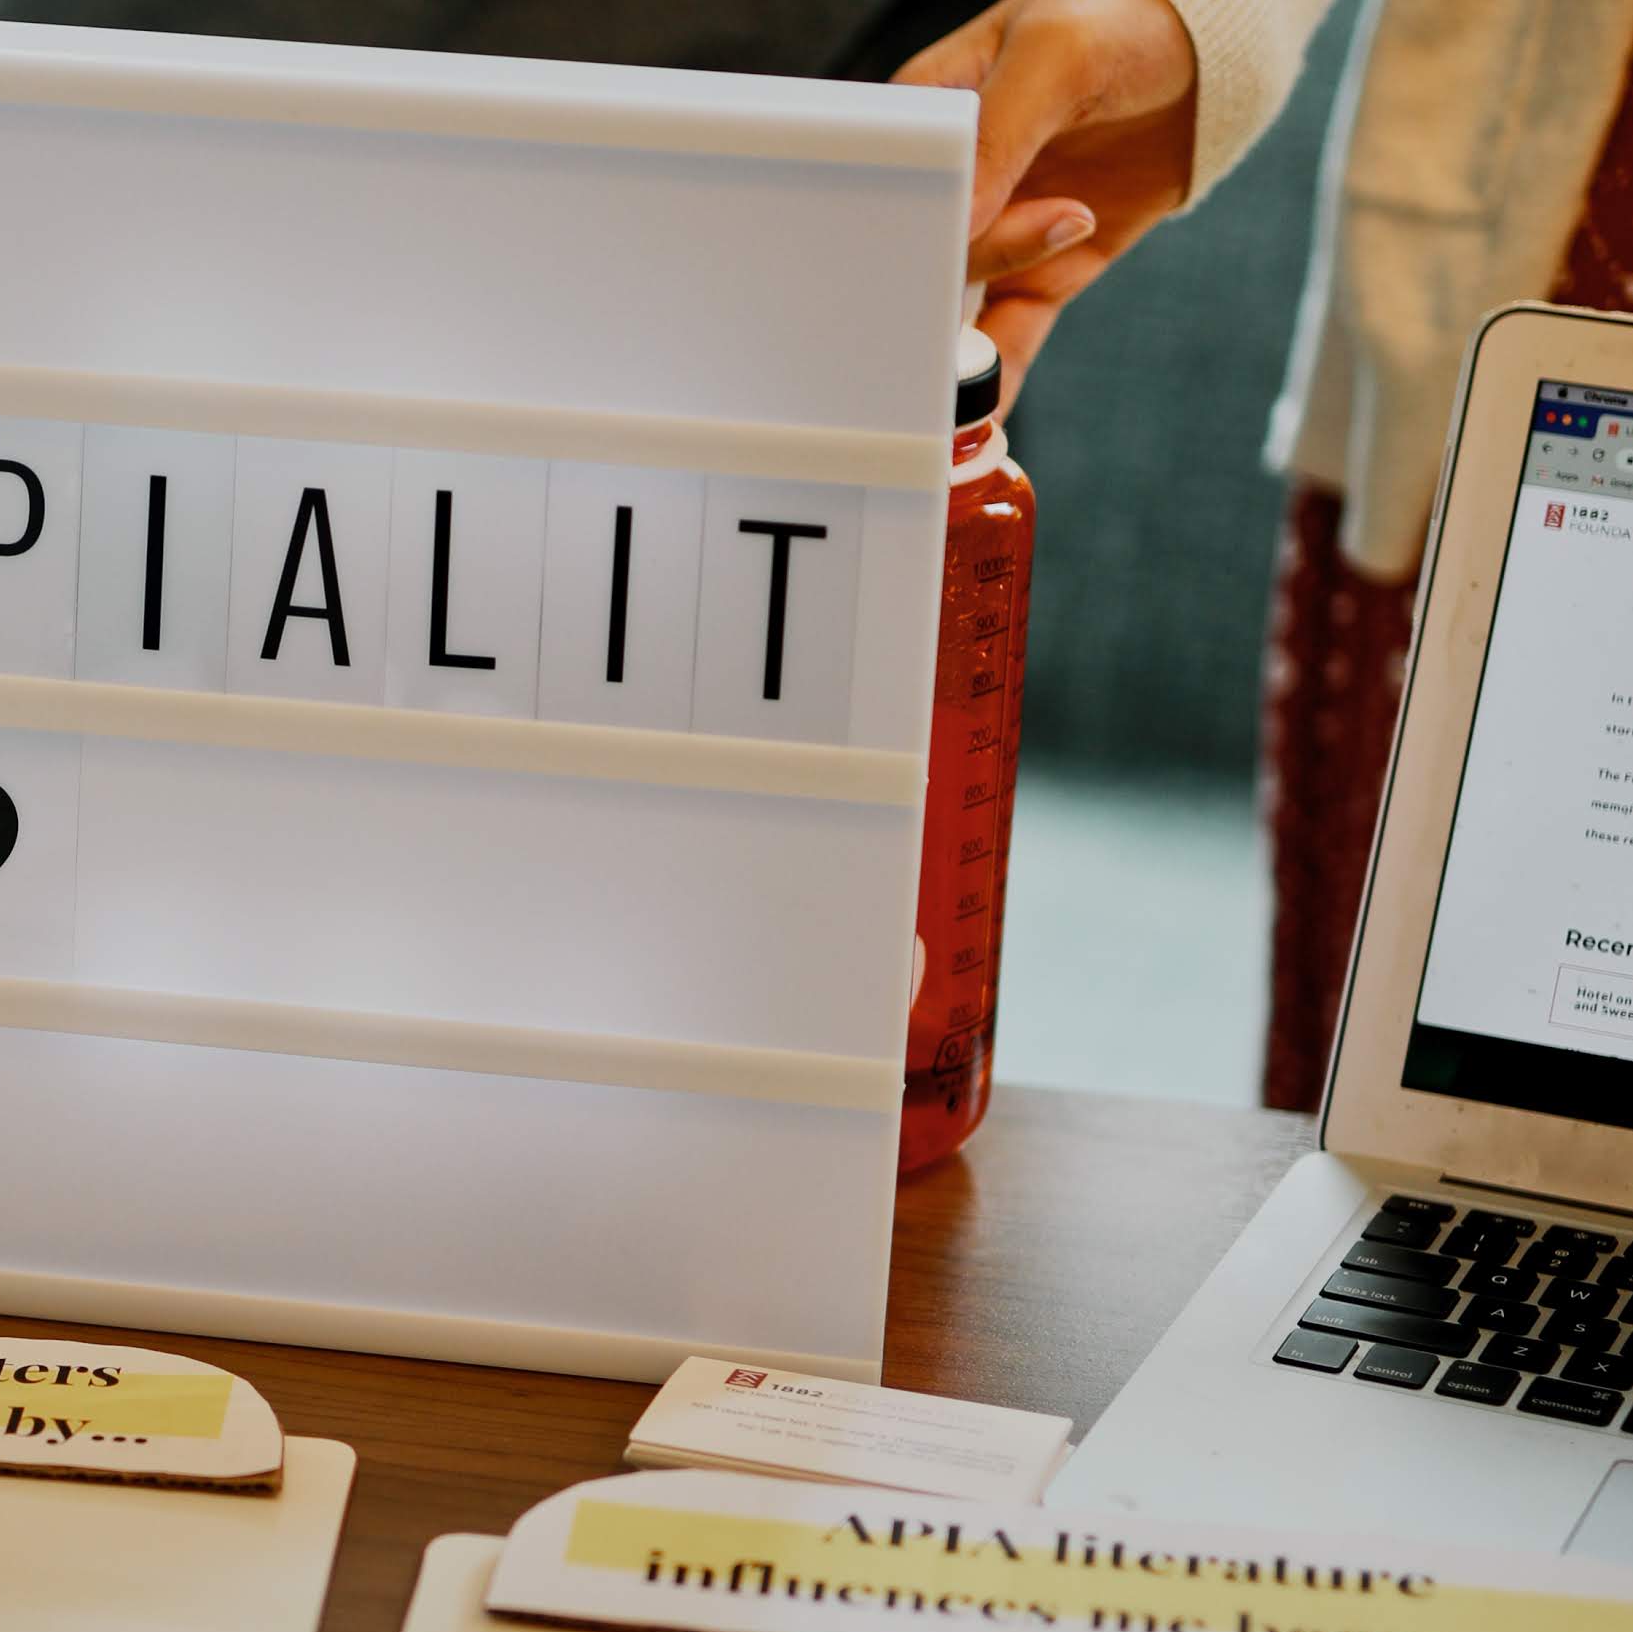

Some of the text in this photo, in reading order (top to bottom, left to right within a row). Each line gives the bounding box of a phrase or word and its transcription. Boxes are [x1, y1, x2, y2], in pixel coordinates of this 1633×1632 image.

[1576, 985, 1613, 1004] Hotel
[1355, 1254, 1379, 1266] tab
[1491, 1273, 1509, 1286] Q
[1336, 1284, 1397, 1303] caps lock
[1570, 1288, 1591, 1302] W
[1315, 1312, 1344, 1326] shift
[1490, 1307, 1506, 1319] A
[1573, 1322, 1586, 1333] S
[1512, 1345, 1529, 1357] Z
[1366, 1364, 1414, 1380] control
[1593, 1361, 1611, 1373] X
[770, 1382, 824, 1399] 1882
[1447, 1379, 1491, 1396] option
[1531, 1396, 1602, 1417] command
[2, 1405, 149, 1446] by...
[822, 1513, 1436, 1599] APIA literature
[642, 1549, 1058, 1625] influences
